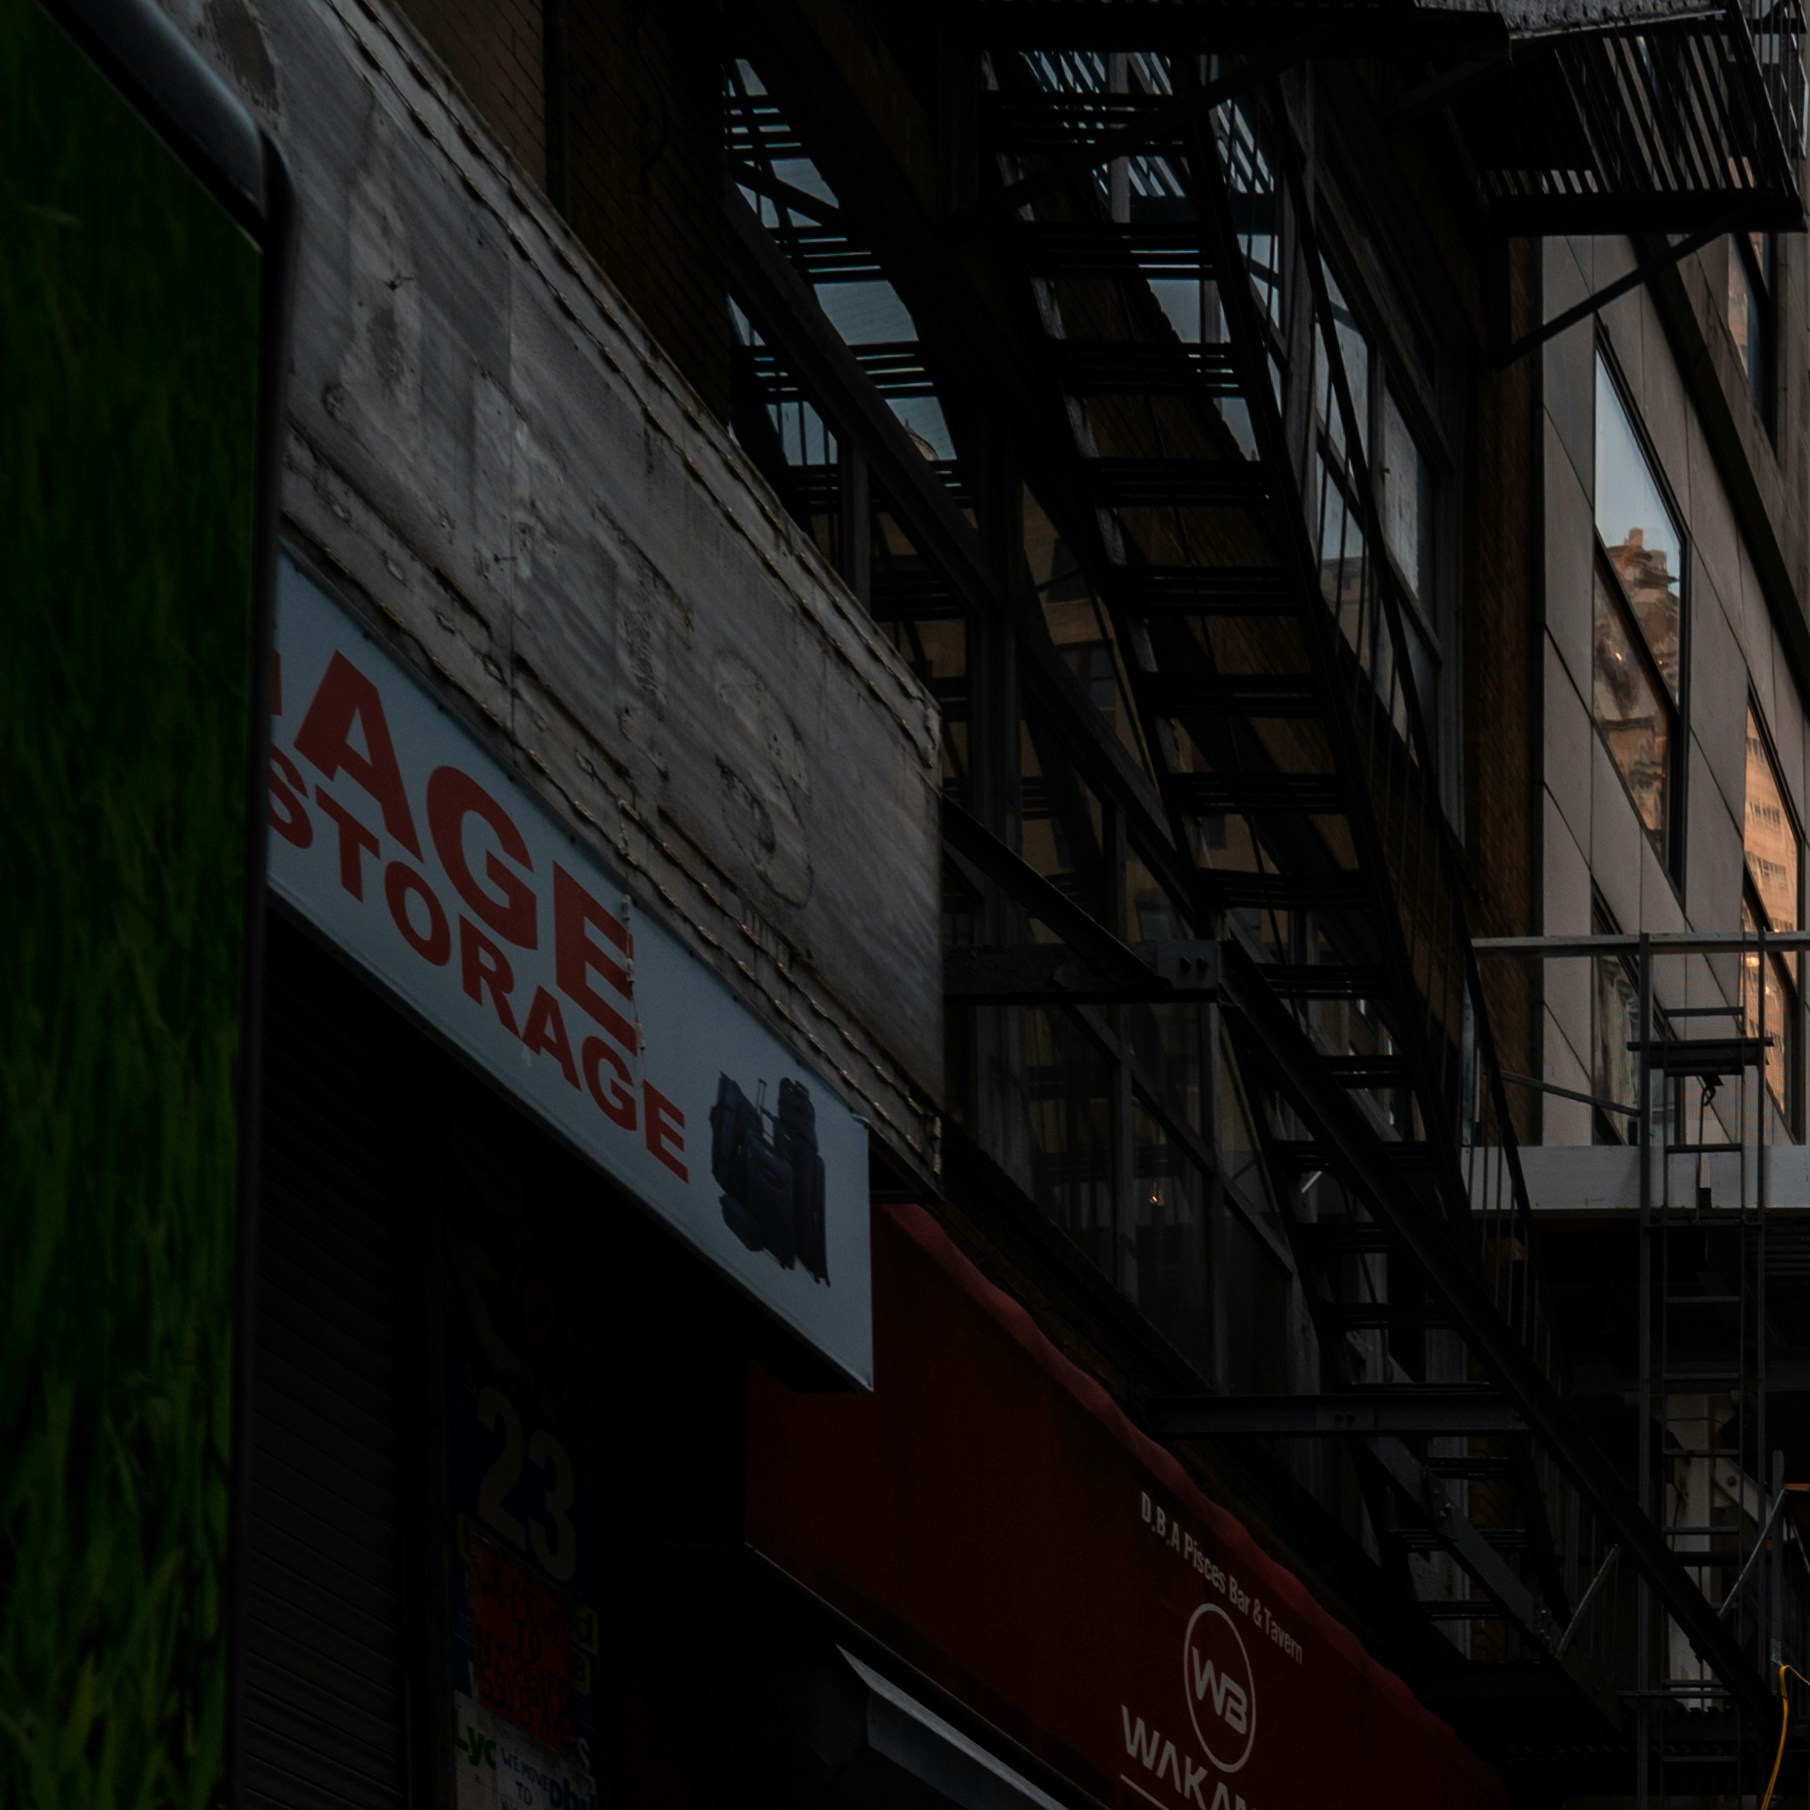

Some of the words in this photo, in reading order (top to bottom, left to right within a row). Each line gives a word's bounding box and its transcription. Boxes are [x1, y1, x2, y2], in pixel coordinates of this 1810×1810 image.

[270, 648, 641, 1058] AGE
[1183, 1531, 1227, 1595] Pisces
[1228, 1574, 1252, 1617] Bar
[1252, 1597, 1263, 1630] &
[1263, 1606, 1304, 1667] Tavern
